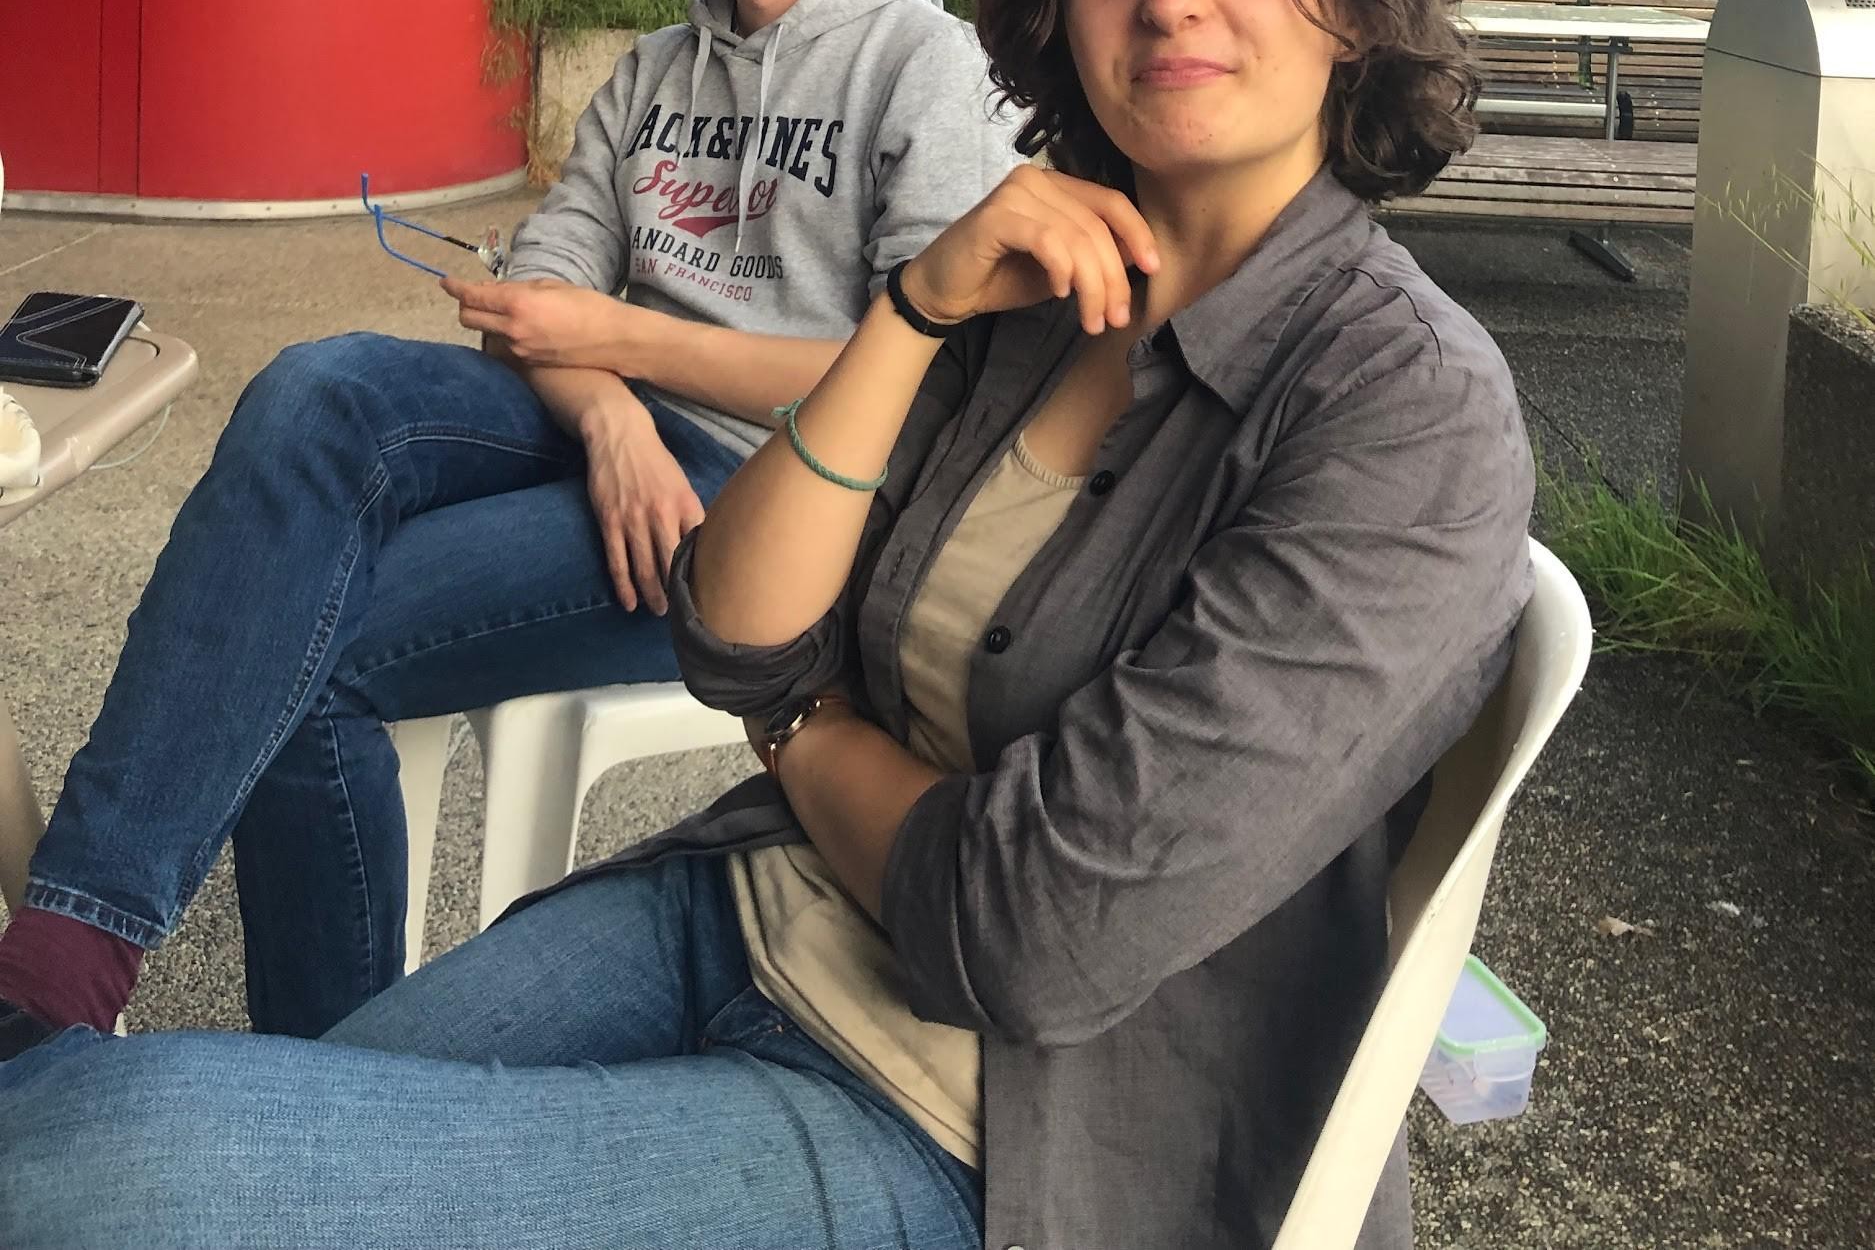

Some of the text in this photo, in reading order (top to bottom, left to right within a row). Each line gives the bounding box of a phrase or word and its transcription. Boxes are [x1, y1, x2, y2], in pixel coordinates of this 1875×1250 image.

[633, 160, 778, 219] Supeor
[630, 226, 784, 279] ANDARD GOODS
[664, 262, 753, 302] FRANCISCO
